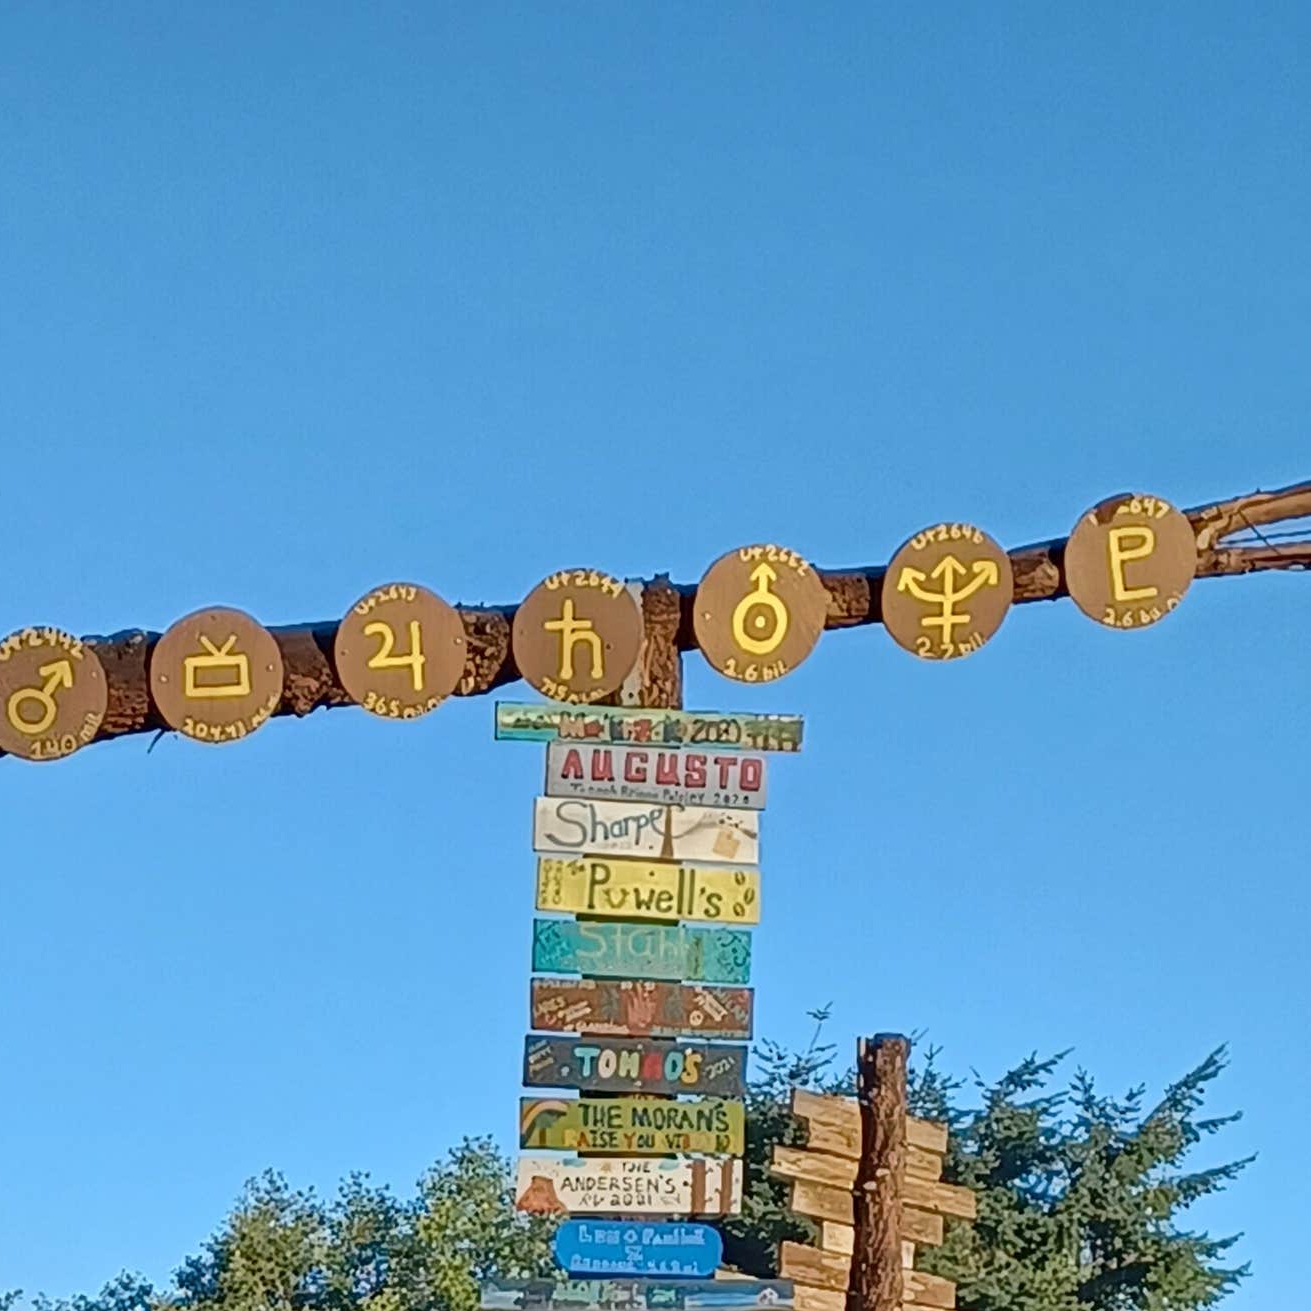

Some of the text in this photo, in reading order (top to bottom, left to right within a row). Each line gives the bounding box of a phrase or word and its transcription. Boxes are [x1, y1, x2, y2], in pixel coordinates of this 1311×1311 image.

[363, 691, 399, 717] 365
[29, 734, 77, 759] 140
[560, 749, 764, 792] AUGUSTO
[586, 862, 724, 919] Powell's
[578, 1102, 730, 1133] THE MORAN'S
[563, 1129, 618, 1149] RAISE
[560, 1175, 677, 1195] ANDERSEN'S
